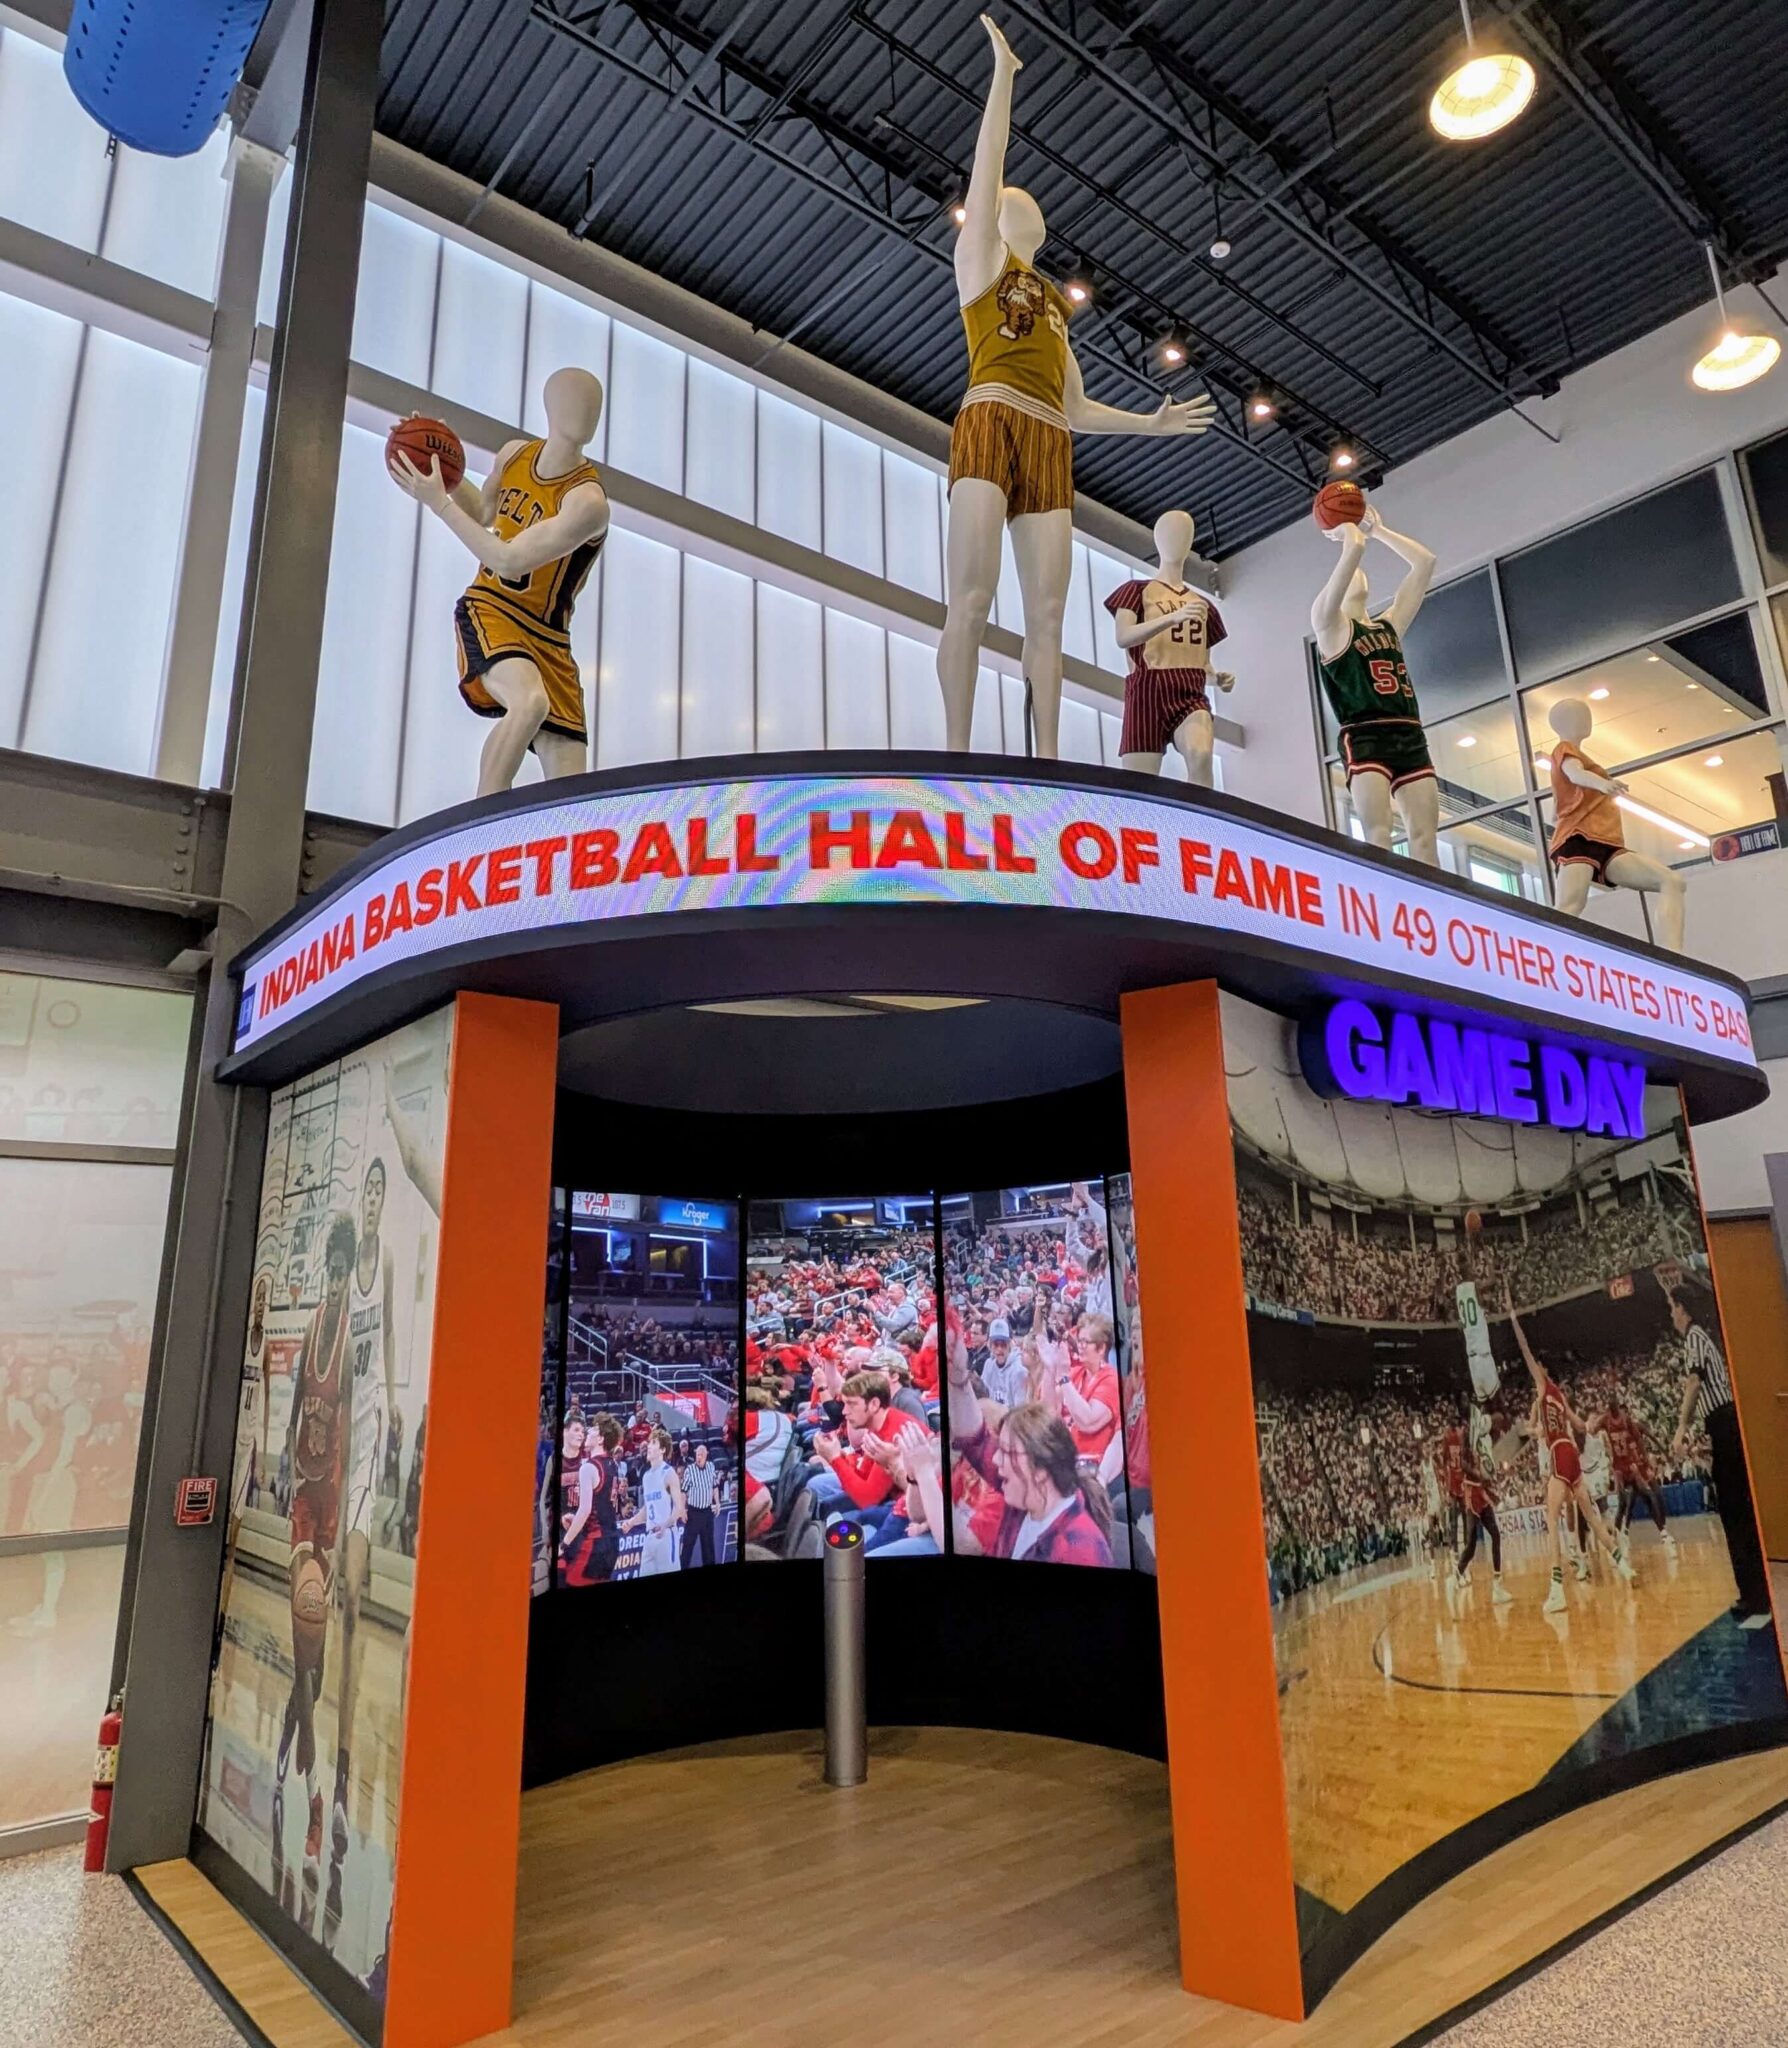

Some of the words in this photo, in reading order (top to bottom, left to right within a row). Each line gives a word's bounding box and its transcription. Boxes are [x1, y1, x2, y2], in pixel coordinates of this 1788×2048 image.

[1171, 619, 1202, 645] 22
[259, 913, 356, 1020] INDIANA
[363, 812, 781, 953] BASKETBALL
[809, 810, 1037, 874] HALL
[1059, 820, 1161, 884] OF
[1179, 837, 1326, 928] FAME
[1337, 883, 1382, 942] IN
[1392, 902, 1438, 957] 49
[1447, 918, 1560, 993] OTHER
[1562, 954, 1661, 1021] STATES
[1663, 985, 1709, 1034] IT'S
[1711, 1000, 1753, 1049] BAS
[1325, 999, 1540, 1124] GAME
[1539, 1045, 1648, 1139] DAY
[681, 1202, 710, 1226] Kroger
[354, 1340, 372, 1378] 30
[187, 1480, 213, 1491] FIRE
[649, 1503, 656, 1521] 3
